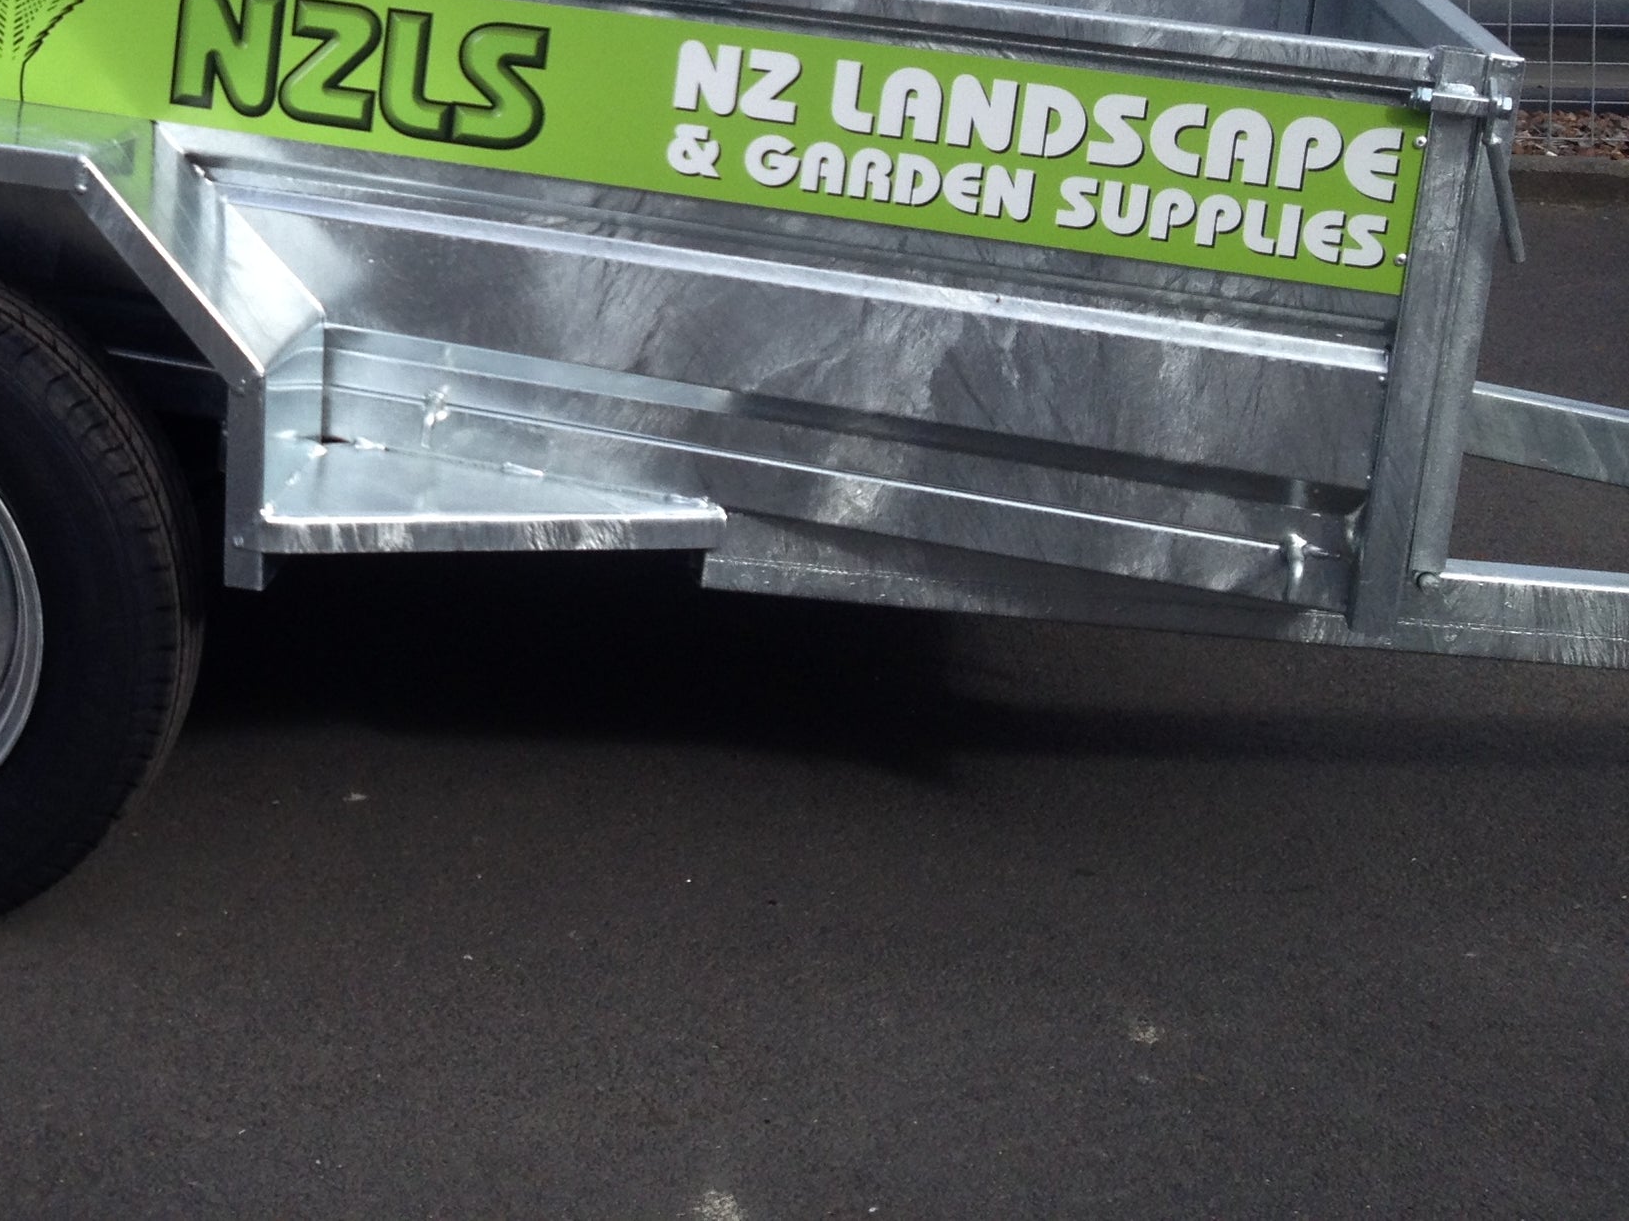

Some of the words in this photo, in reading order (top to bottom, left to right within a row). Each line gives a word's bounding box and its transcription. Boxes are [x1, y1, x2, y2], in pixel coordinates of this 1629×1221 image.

[666, 125, 720, 179] &
[744, 134, 1034, 222] GARDEN
[1055, 175, 1389, 268] SUPPLIES
[673, 39, 803, 124] NZ
[830, 59, 1404, 202] LANDSCAPE
